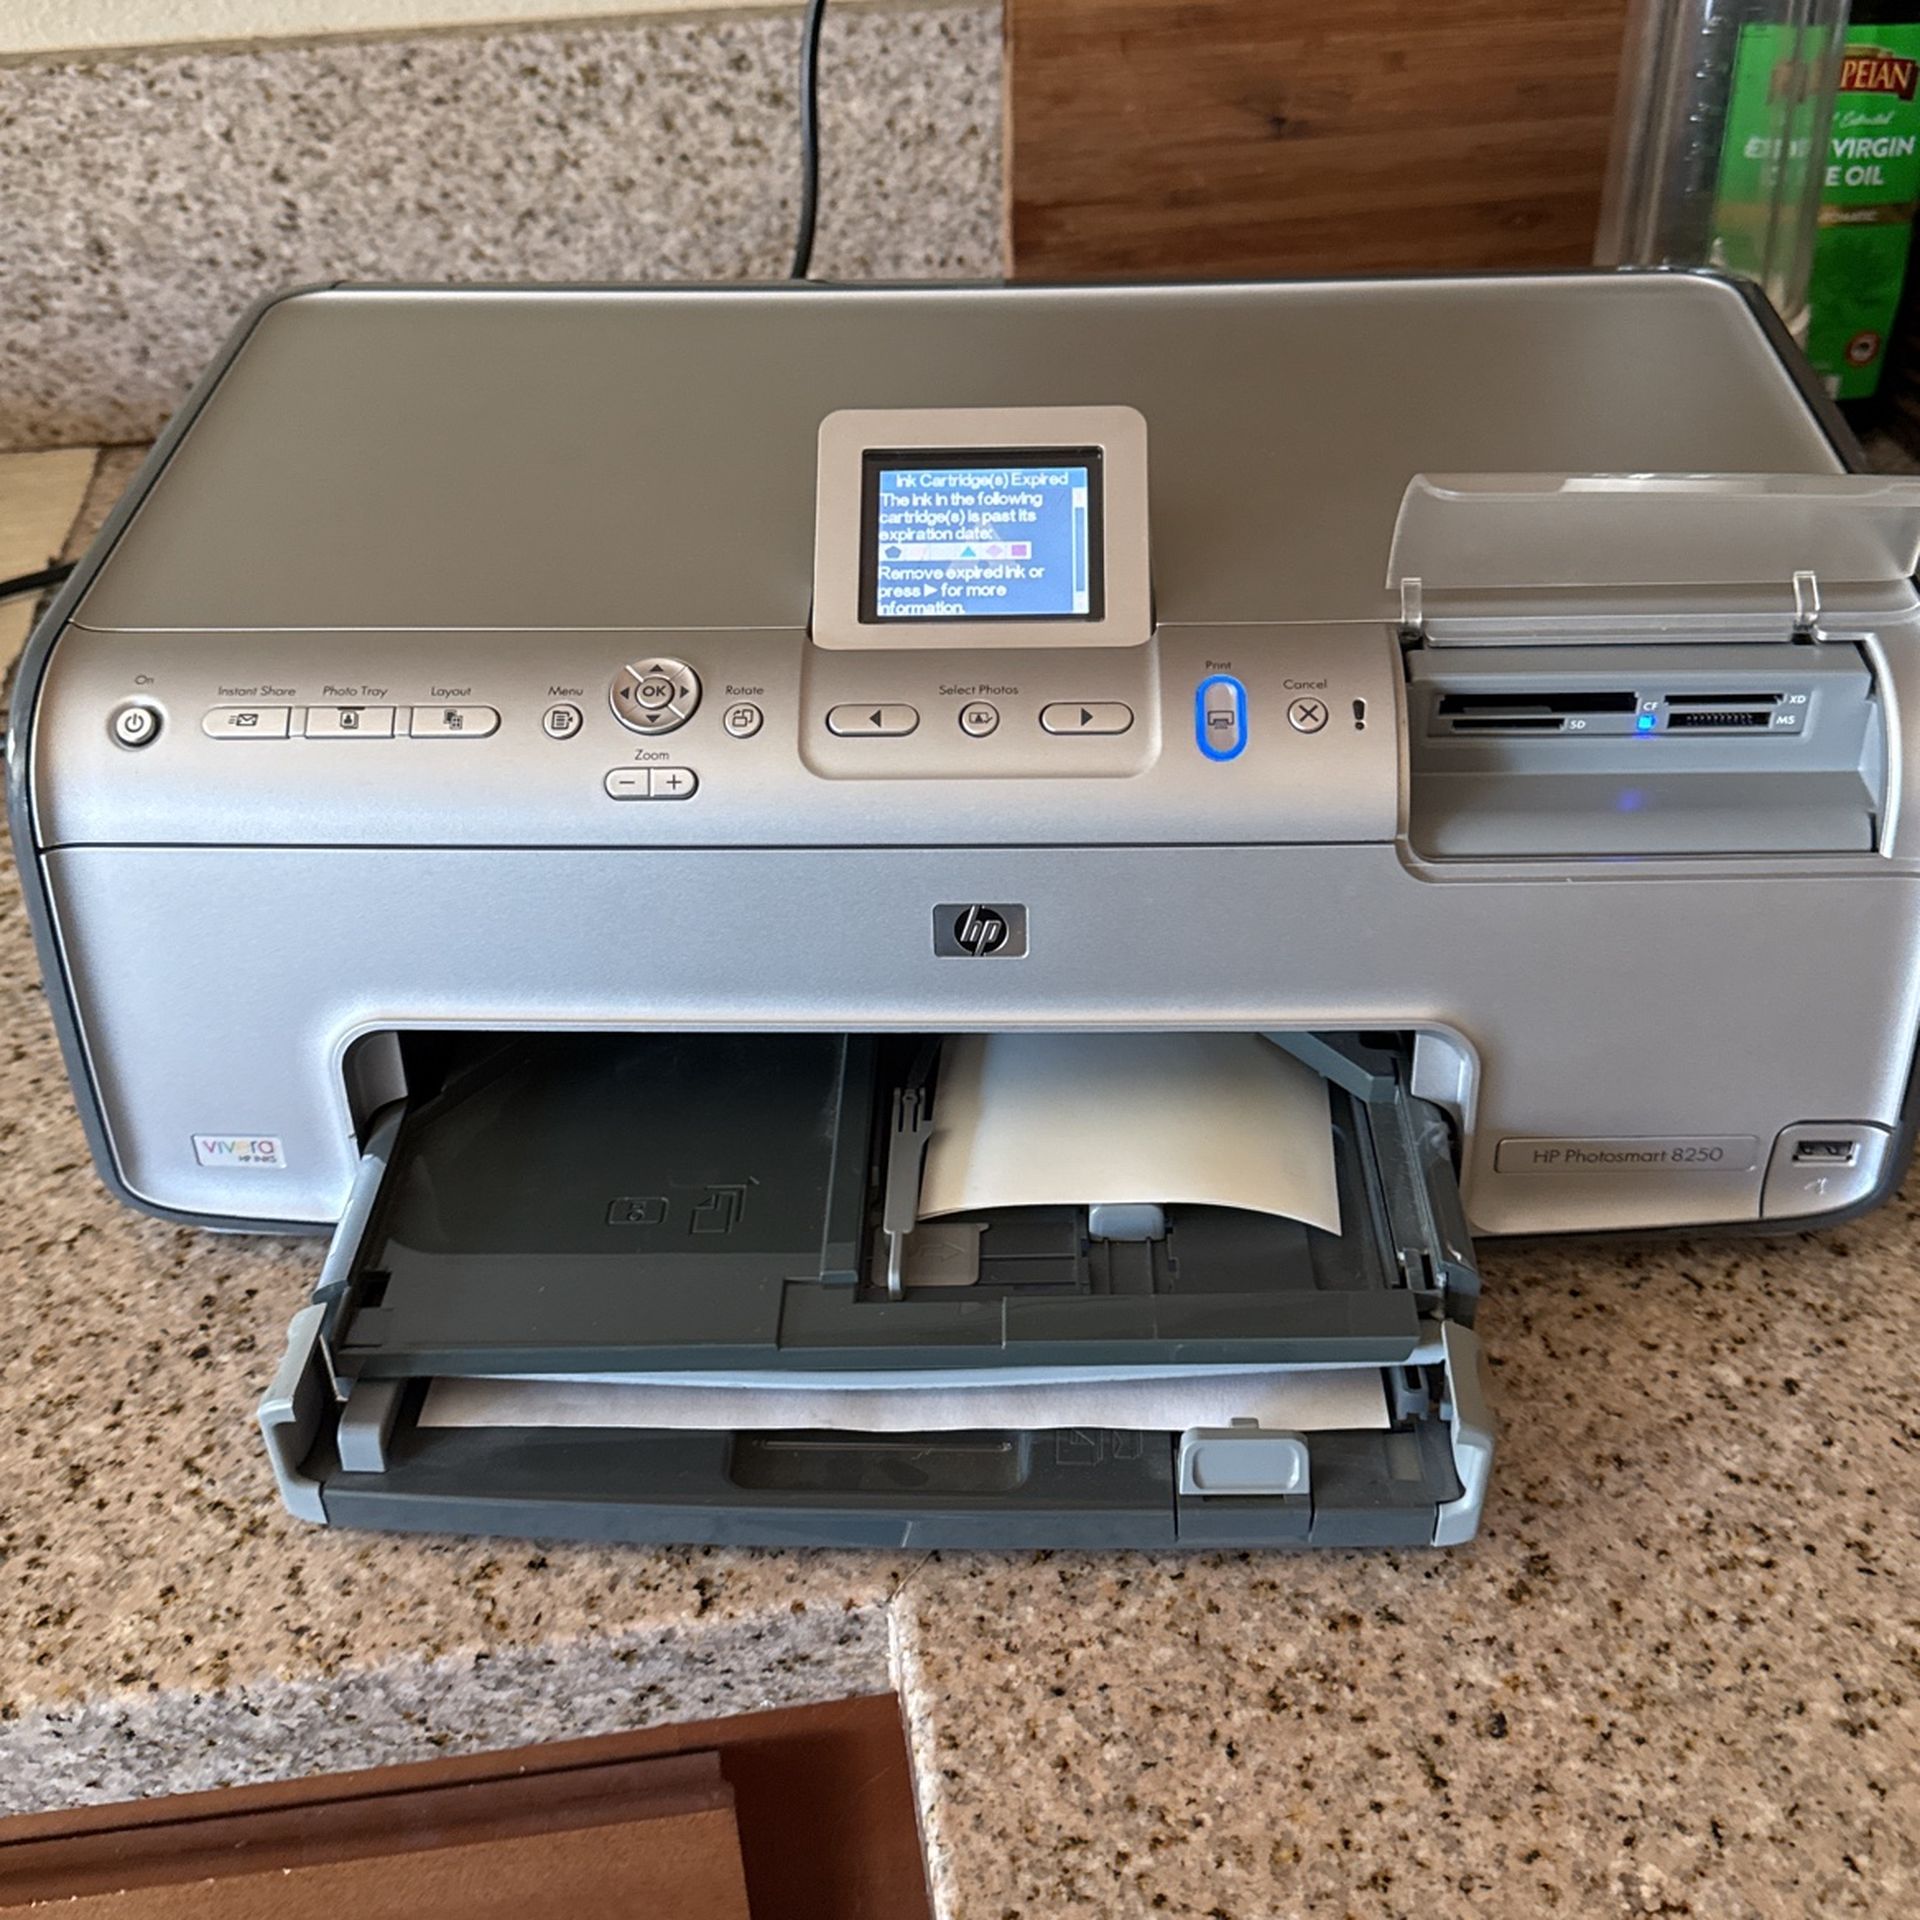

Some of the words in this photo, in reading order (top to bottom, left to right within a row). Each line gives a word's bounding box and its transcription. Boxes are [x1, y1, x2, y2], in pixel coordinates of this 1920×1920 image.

[1832, 135, 1916, 159] VIRGIN
[1844, 164, 1885, 187] OIL
[896, 473, 917, 488] Ink
[919, 472, 1009, 490] Cartridge(s)
[1011, 471, 1069, 489] Expired
[880, 492, 910, 507] The
[911, 492, 934, 507] ink
[935, 492, 949, 506] in
[950, 491, 976, 506] the
[977, 491, 1043, 508] following
[879, 508, 966, 527] cartridge(s)
[967, 509, 981, 523] is
[981, 508, 1017, 526] past
[1018, 508, 1038, 523] its
[879, 527, 953, 544] expiration
[954, 526, 993, 541] date:
[878, 565, 944, 581] Remove
[945, 563, 1004, 583] expired
[1004, 564, 1026, 579] ink
[1028, 566, 1046, 579] or
[879, 585, 922, 600] press
[940, 582, 963, 597] for
[965, 585, 1007, 598] more
[1205, 660, 1232, 670] Print
[134, 674, 154, 685] On
[1282, 679, 1328, 690] Cancel
[217, 685, 258, 697] Instant
[260, 685, 297, 697] Share
[322, 685, 358, 697] Photo
[360, 685, 389, 699] Tray
[430, 686, 471, 699] Layout
[547, 685, 584, 697] Menu
[642, 685, 667, 697] OK
[725, 684, 765, 696] Rotate
[939, 684, 976, 695] Select
[978, 684, 1019, 695] Photos
[1642, 702, 1659, 711] CF
[1569, 720, 1587, 730] SD
[1775, 715, 1796, 725] MS
[634, 749, 670, 761] Zoom
[959, 905, 1003, 957] hp
[1532, 1149, 1562, 1163] HP
[1564, 1148, 1668, 1164] Photosmart
[1671, 1147, 1724, 1163] 8250
